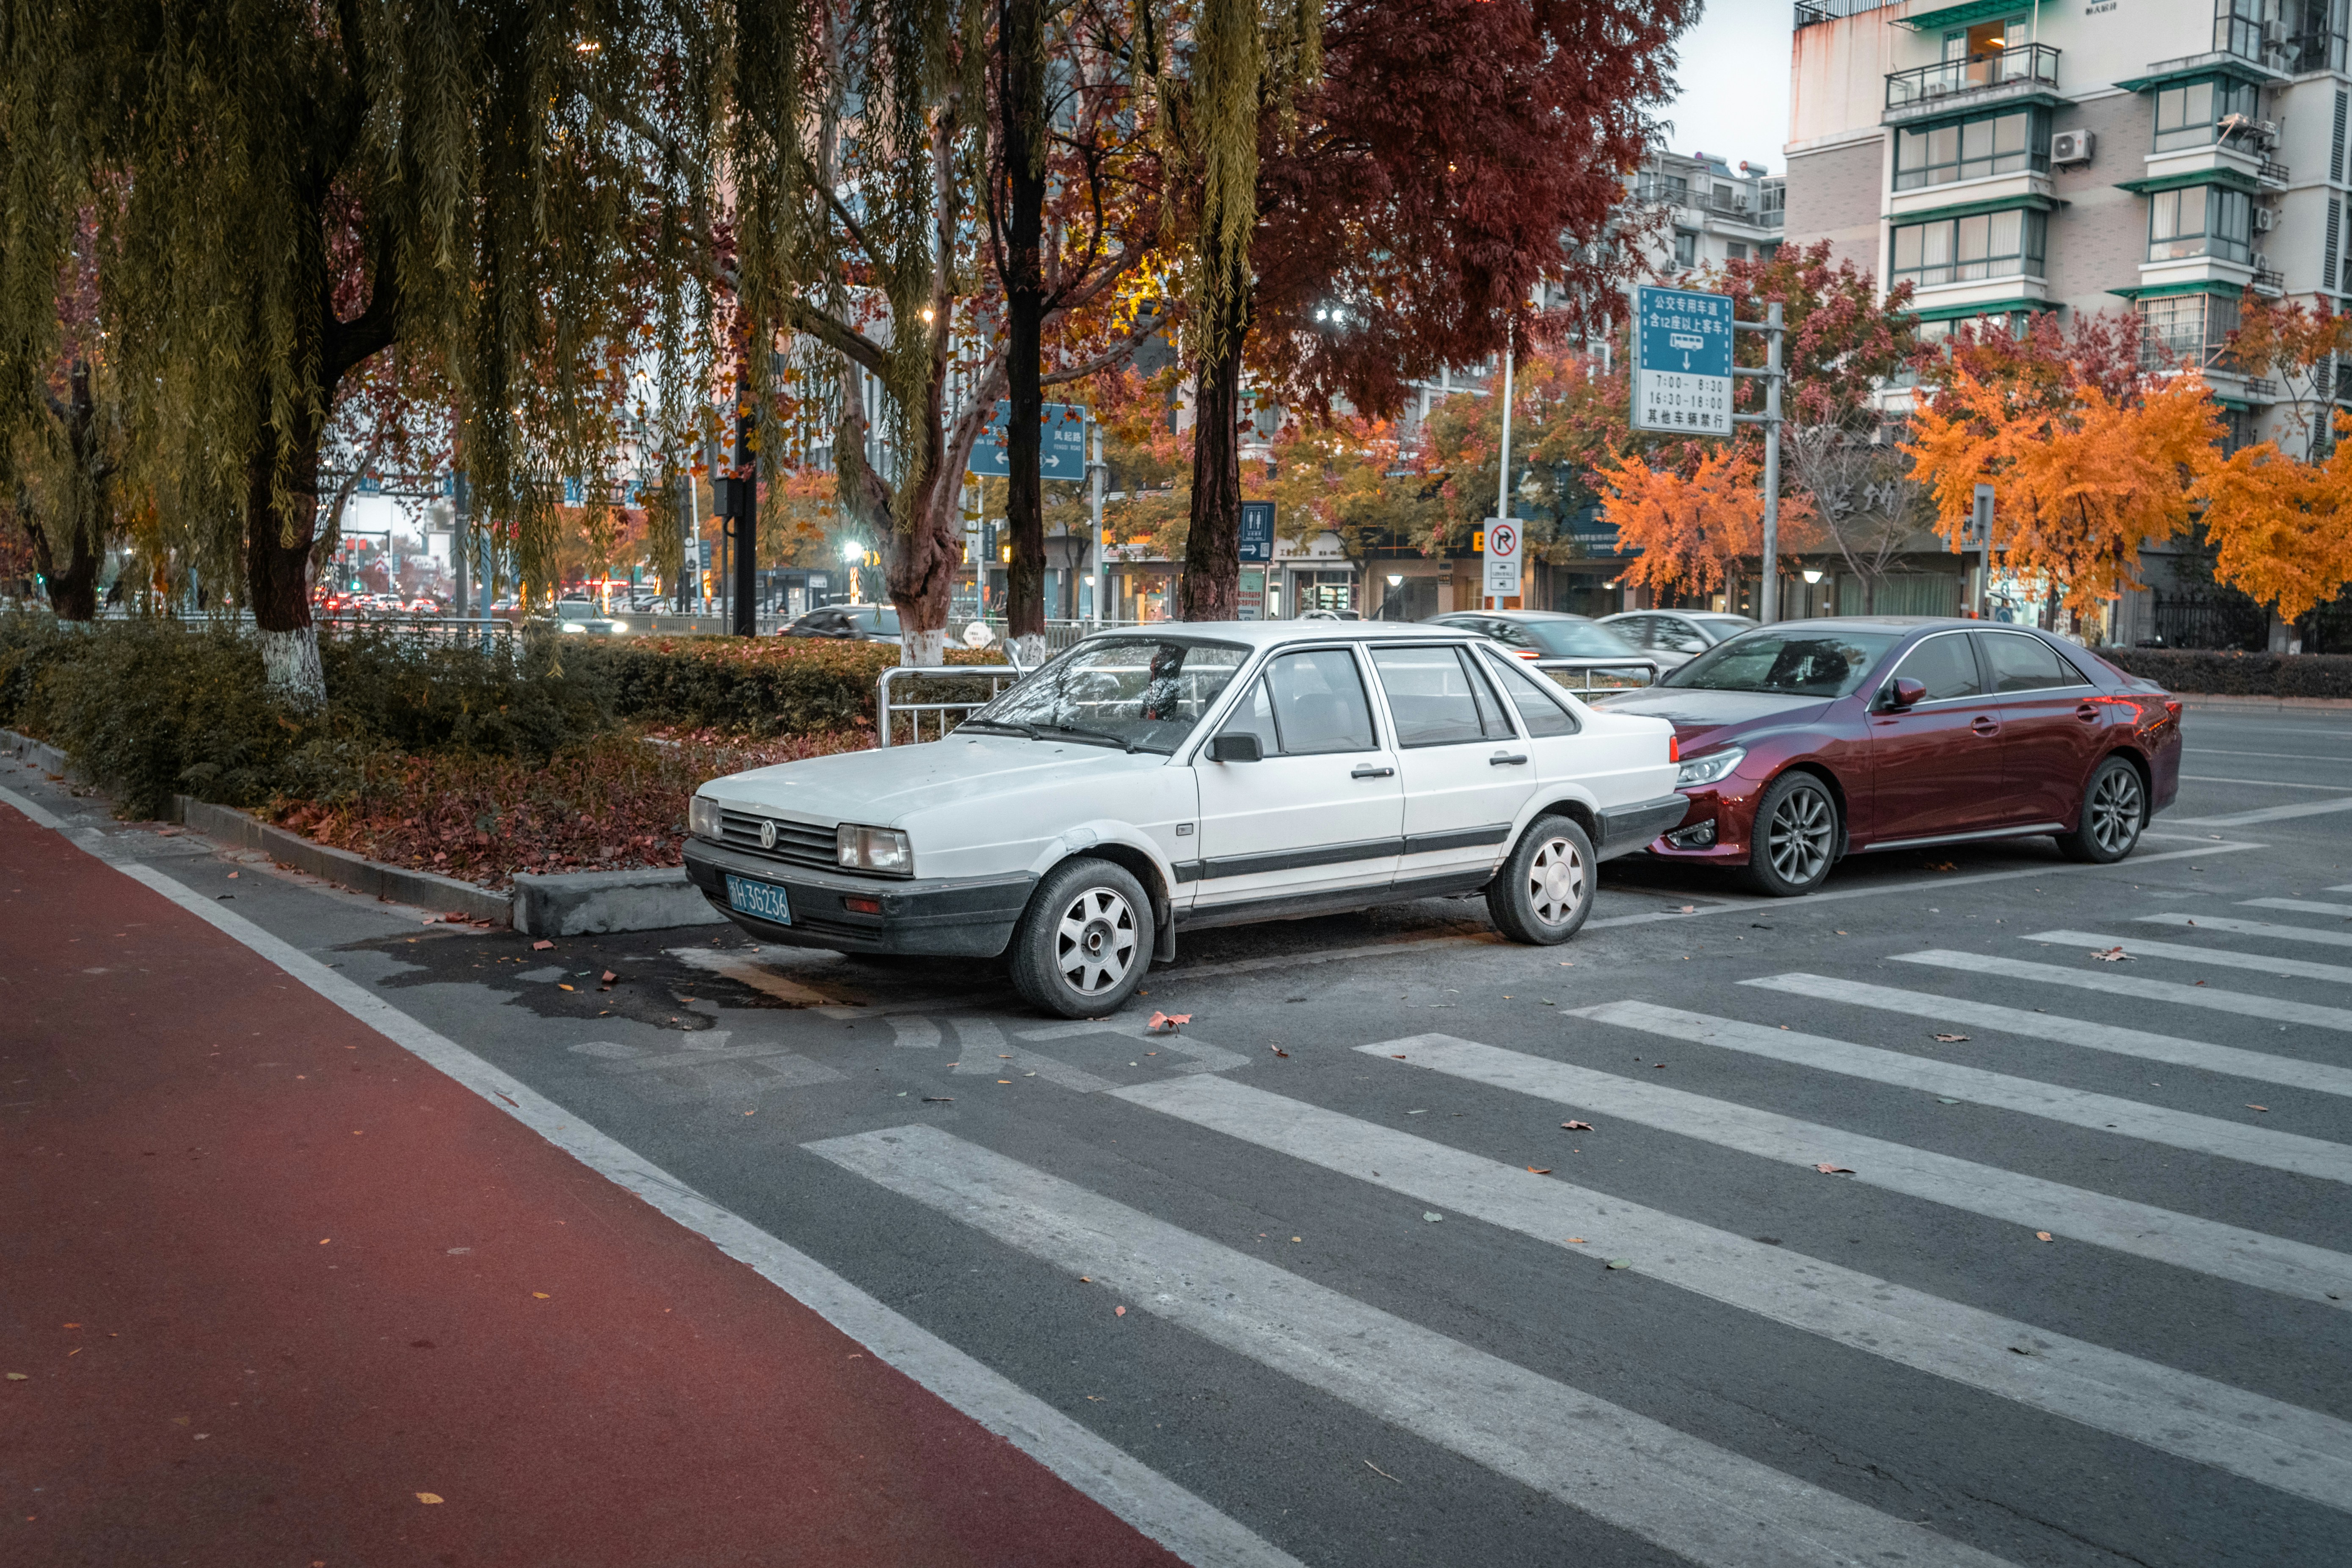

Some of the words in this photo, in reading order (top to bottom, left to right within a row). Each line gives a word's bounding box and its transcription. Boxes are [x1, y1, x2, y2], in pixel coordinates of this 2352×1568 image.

[1654, 295, 1718, 316] 公交专用车道
[1650, 312, 1723, 334] 含12座以上客车
[1648, 408, 1723, 428] 其他车辆禁行
